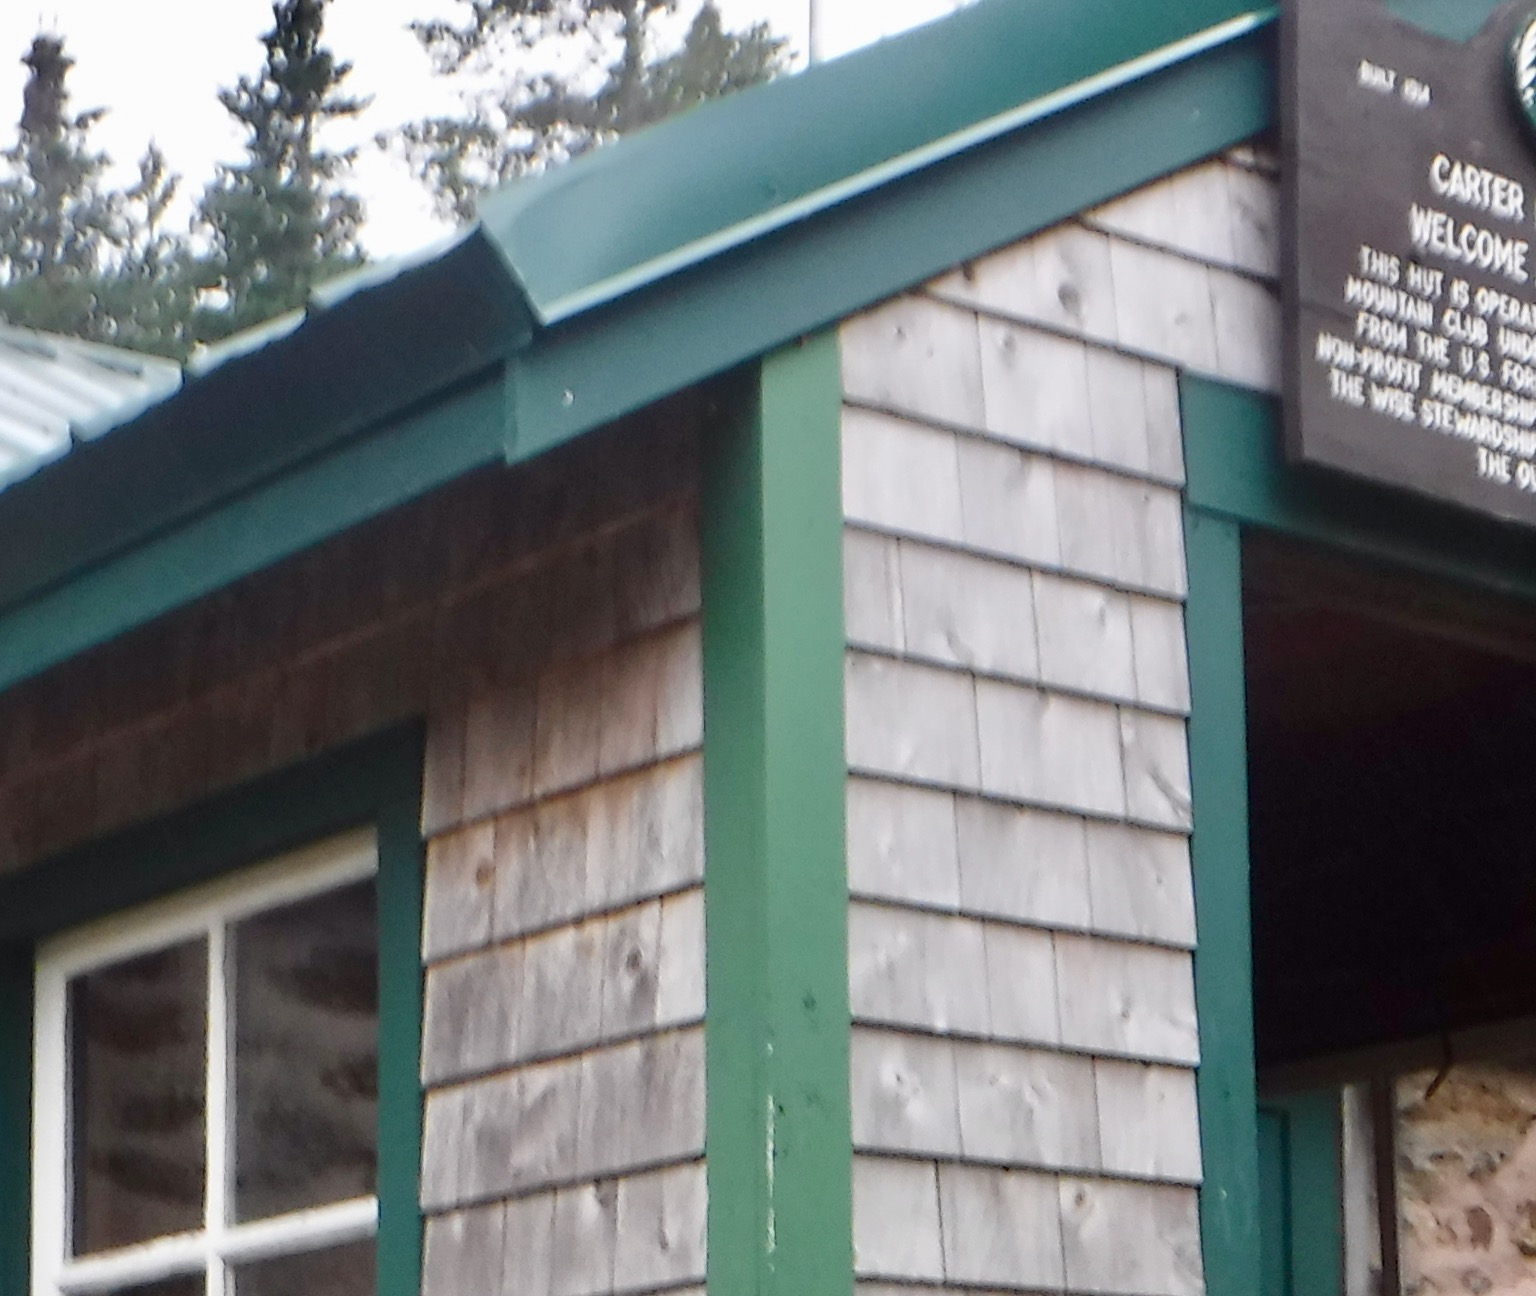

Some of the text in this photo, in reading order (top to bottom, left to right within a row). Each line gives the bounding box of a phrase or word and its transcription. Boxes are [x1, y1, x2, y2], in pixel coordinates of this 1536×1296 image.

[1429, 153, 1524, 221] CARTER
[1409, 204, 1529, 283] WELCOME
[1360, 245, 1400, 285] THIS
[1406, 262, 1443, 299] HUT
[1449, 278, 1470, 310] IS
[1344, 275, 1433, 330] MOUNTAIN
[1441, 308, 1488, 347] CLUB
[1355, 310, 1408, 352] FROM
[1415, 330, 1451, 367] THE
[1316, 332, 1422, 391] NON-PROFIT
[1330, 368, 1365, 406] THE
[1370, 382, 1416, 422] WISE
[1477, 447, 1512, 484] THE
